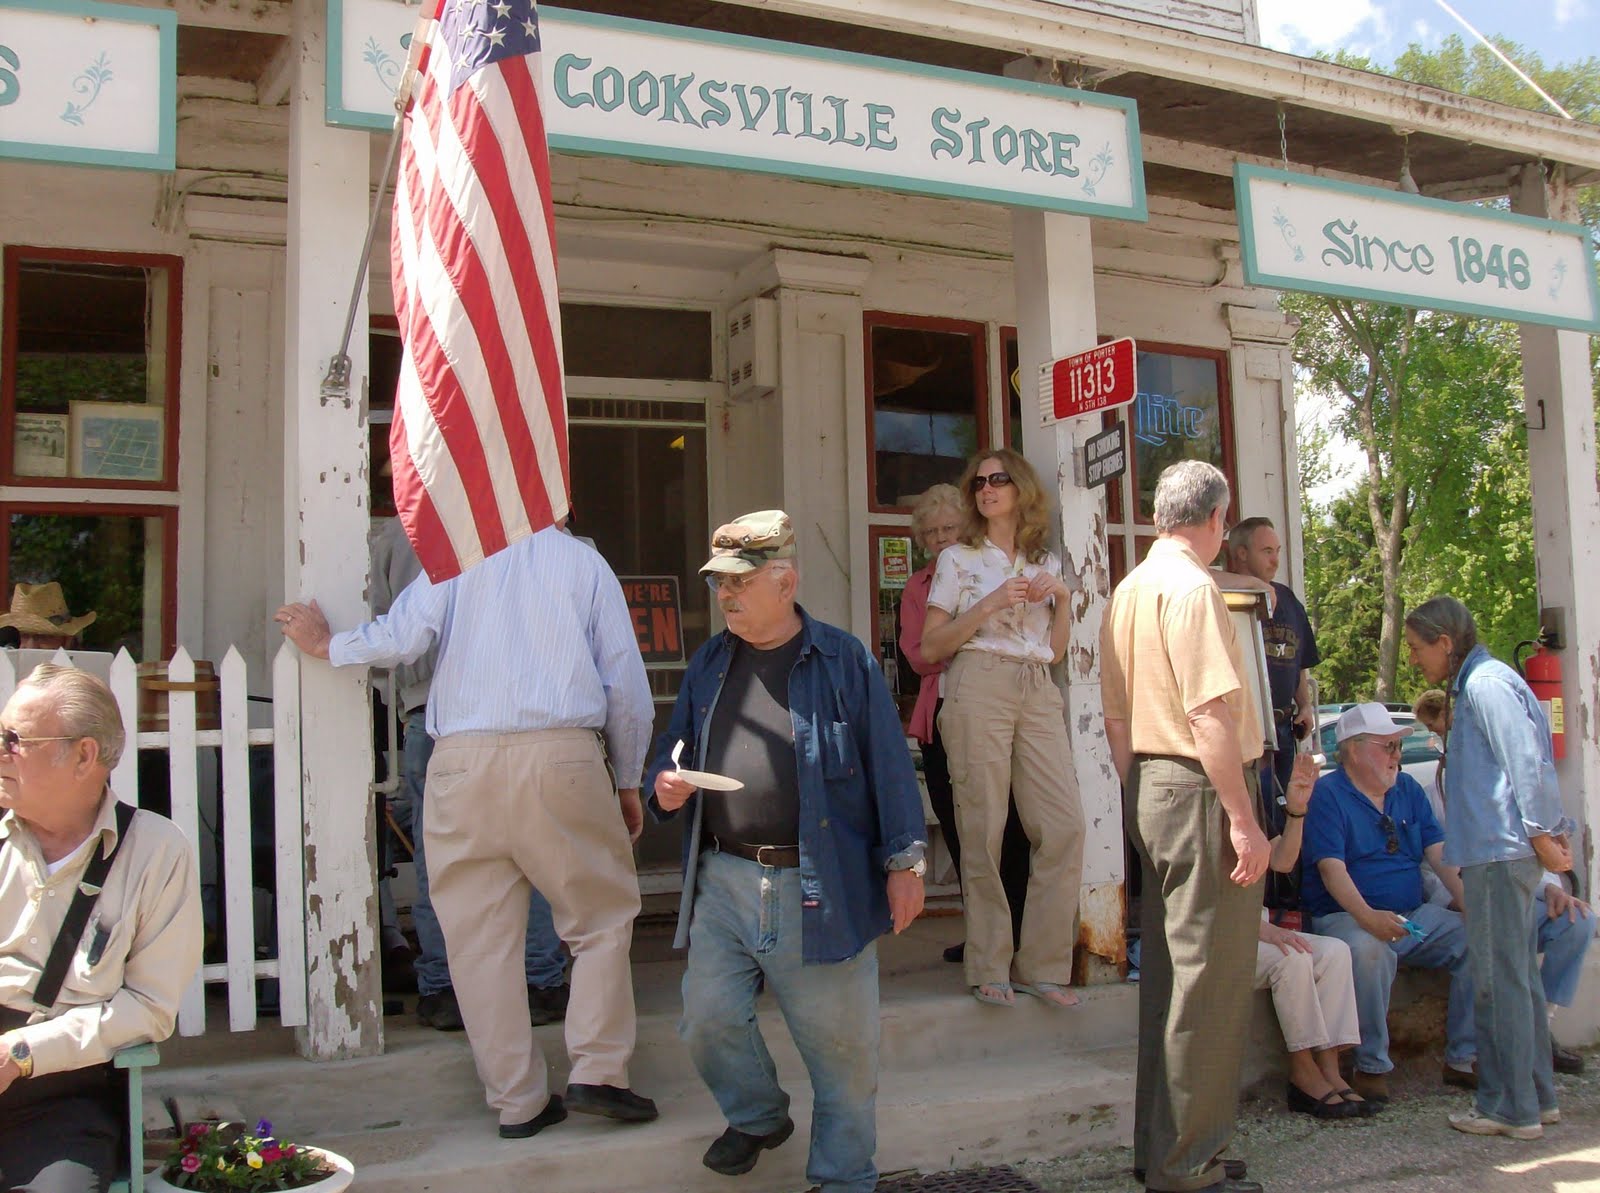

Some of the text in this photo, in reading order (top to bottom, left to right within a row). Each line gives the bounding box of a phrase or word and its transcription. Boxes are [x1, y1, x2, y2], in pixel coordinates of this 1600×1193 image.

[553, 53, 1081, 178] COOKSVILLE STORE
[1321, 218, 1531, 291] Since 1846
[1068, 345, 1116, 368] TOWN OF PORTER
[1069, 357, 1116, 403] 11313
[1084, 399, 1096, 410] STH
[1097, 395, 1107, 407] 138
[1135, 392, 1204, 447] Lite
[1087, 429, 1120, 462] NO SMOKING
[1088, 450, 1124, 484] STOP ENGINES
[629, 607, 679, 653] EN
